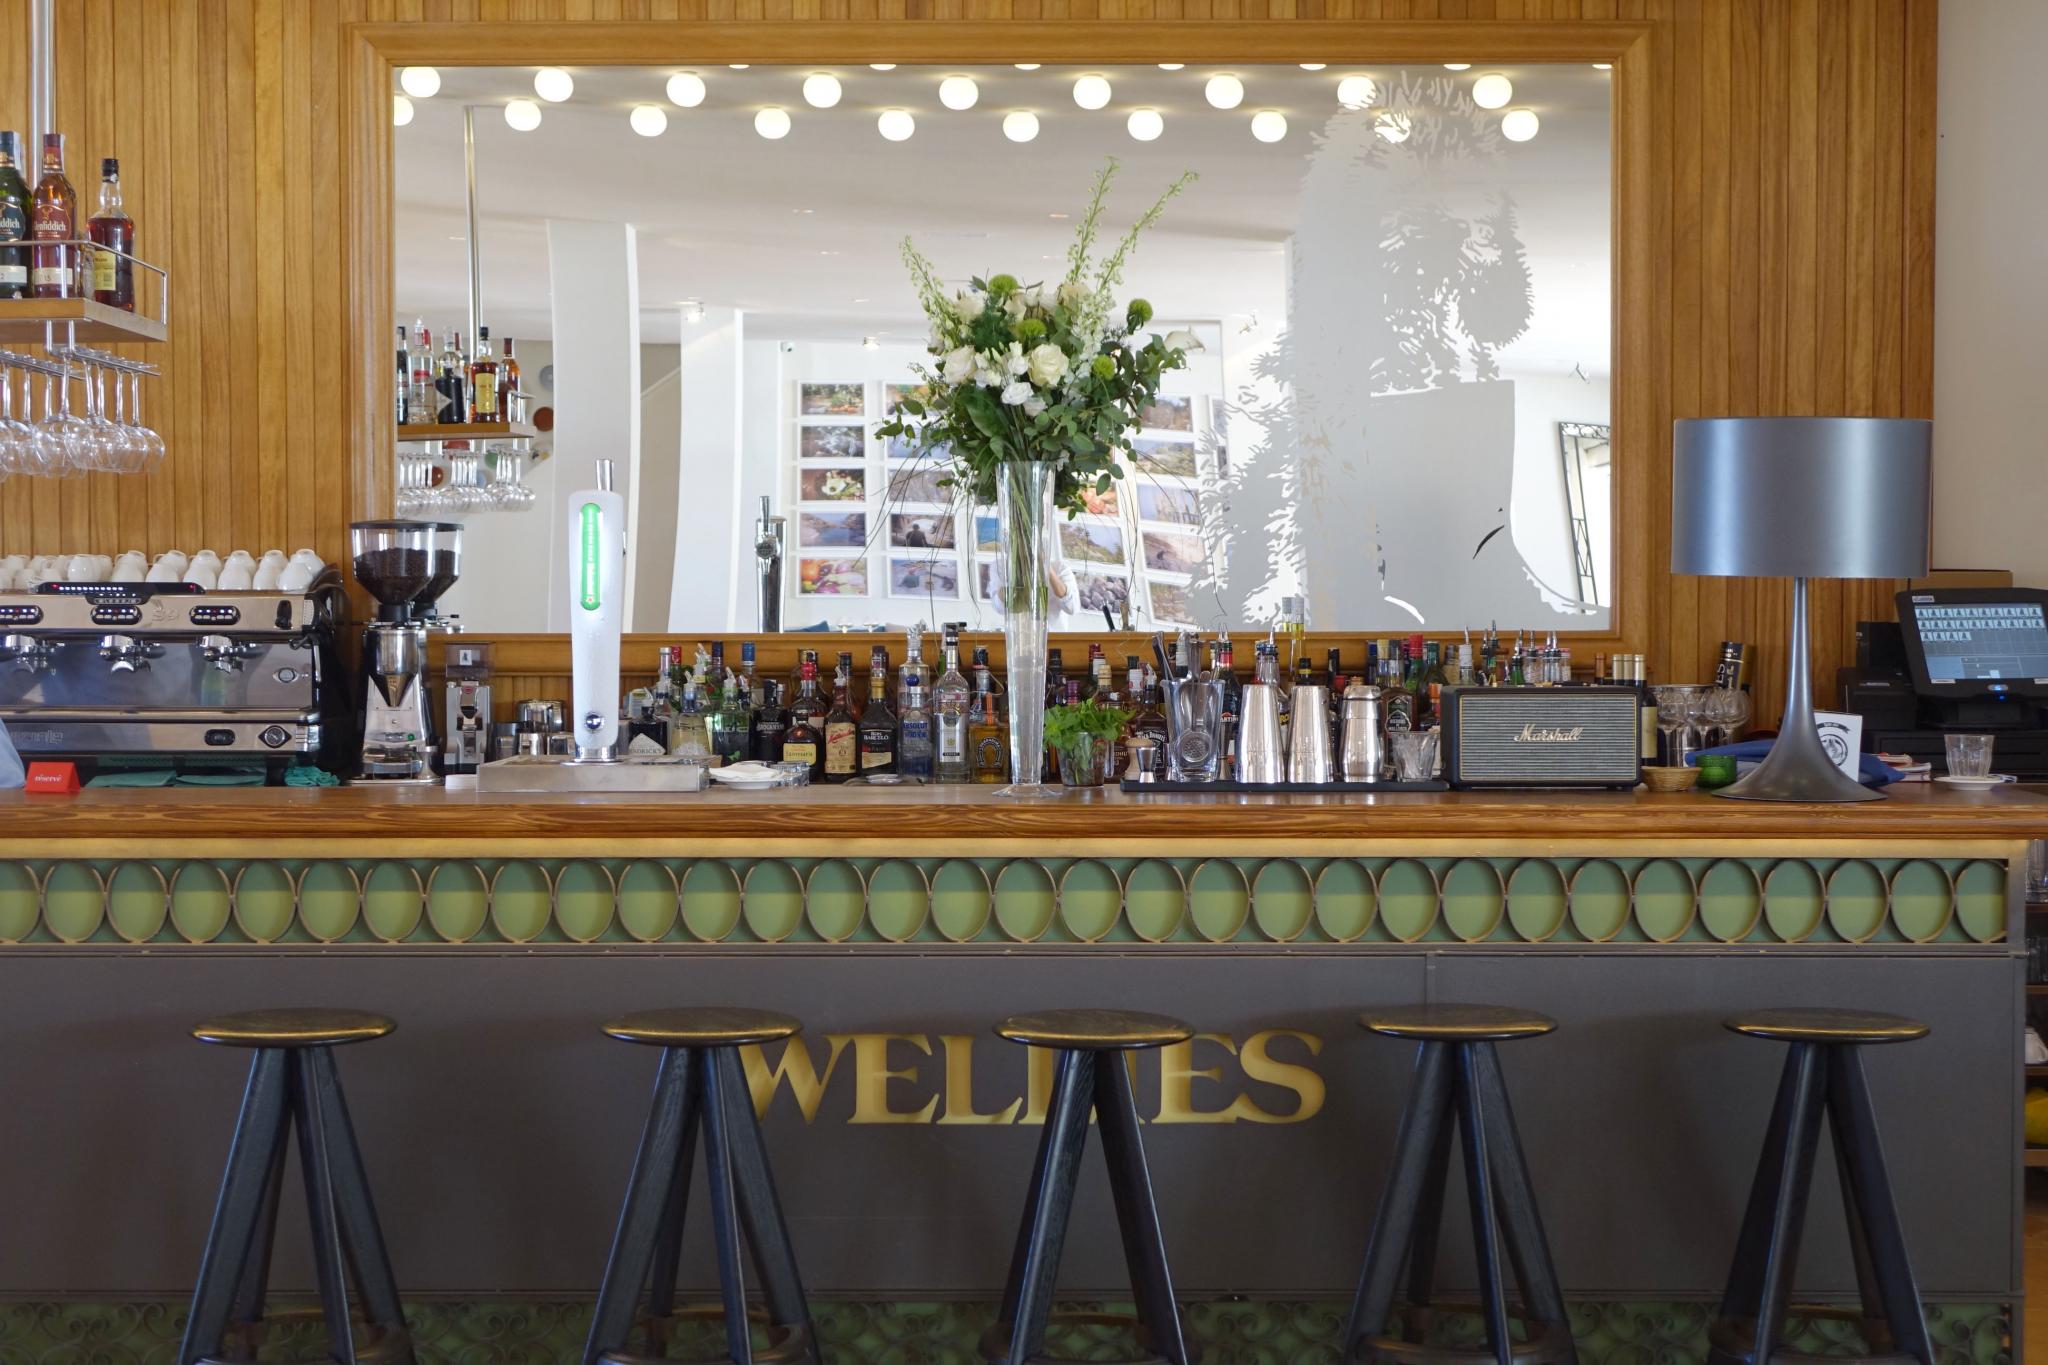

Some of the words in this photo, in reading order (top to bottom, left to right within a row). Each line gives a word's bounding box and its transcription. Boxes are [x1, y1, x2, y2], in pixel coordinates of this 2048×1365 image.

[34, 220, 66, 232] lenfiddich
[1513, 723, 1583, 743] Marshall
[737, 1029, 1325, 1125] WELES
